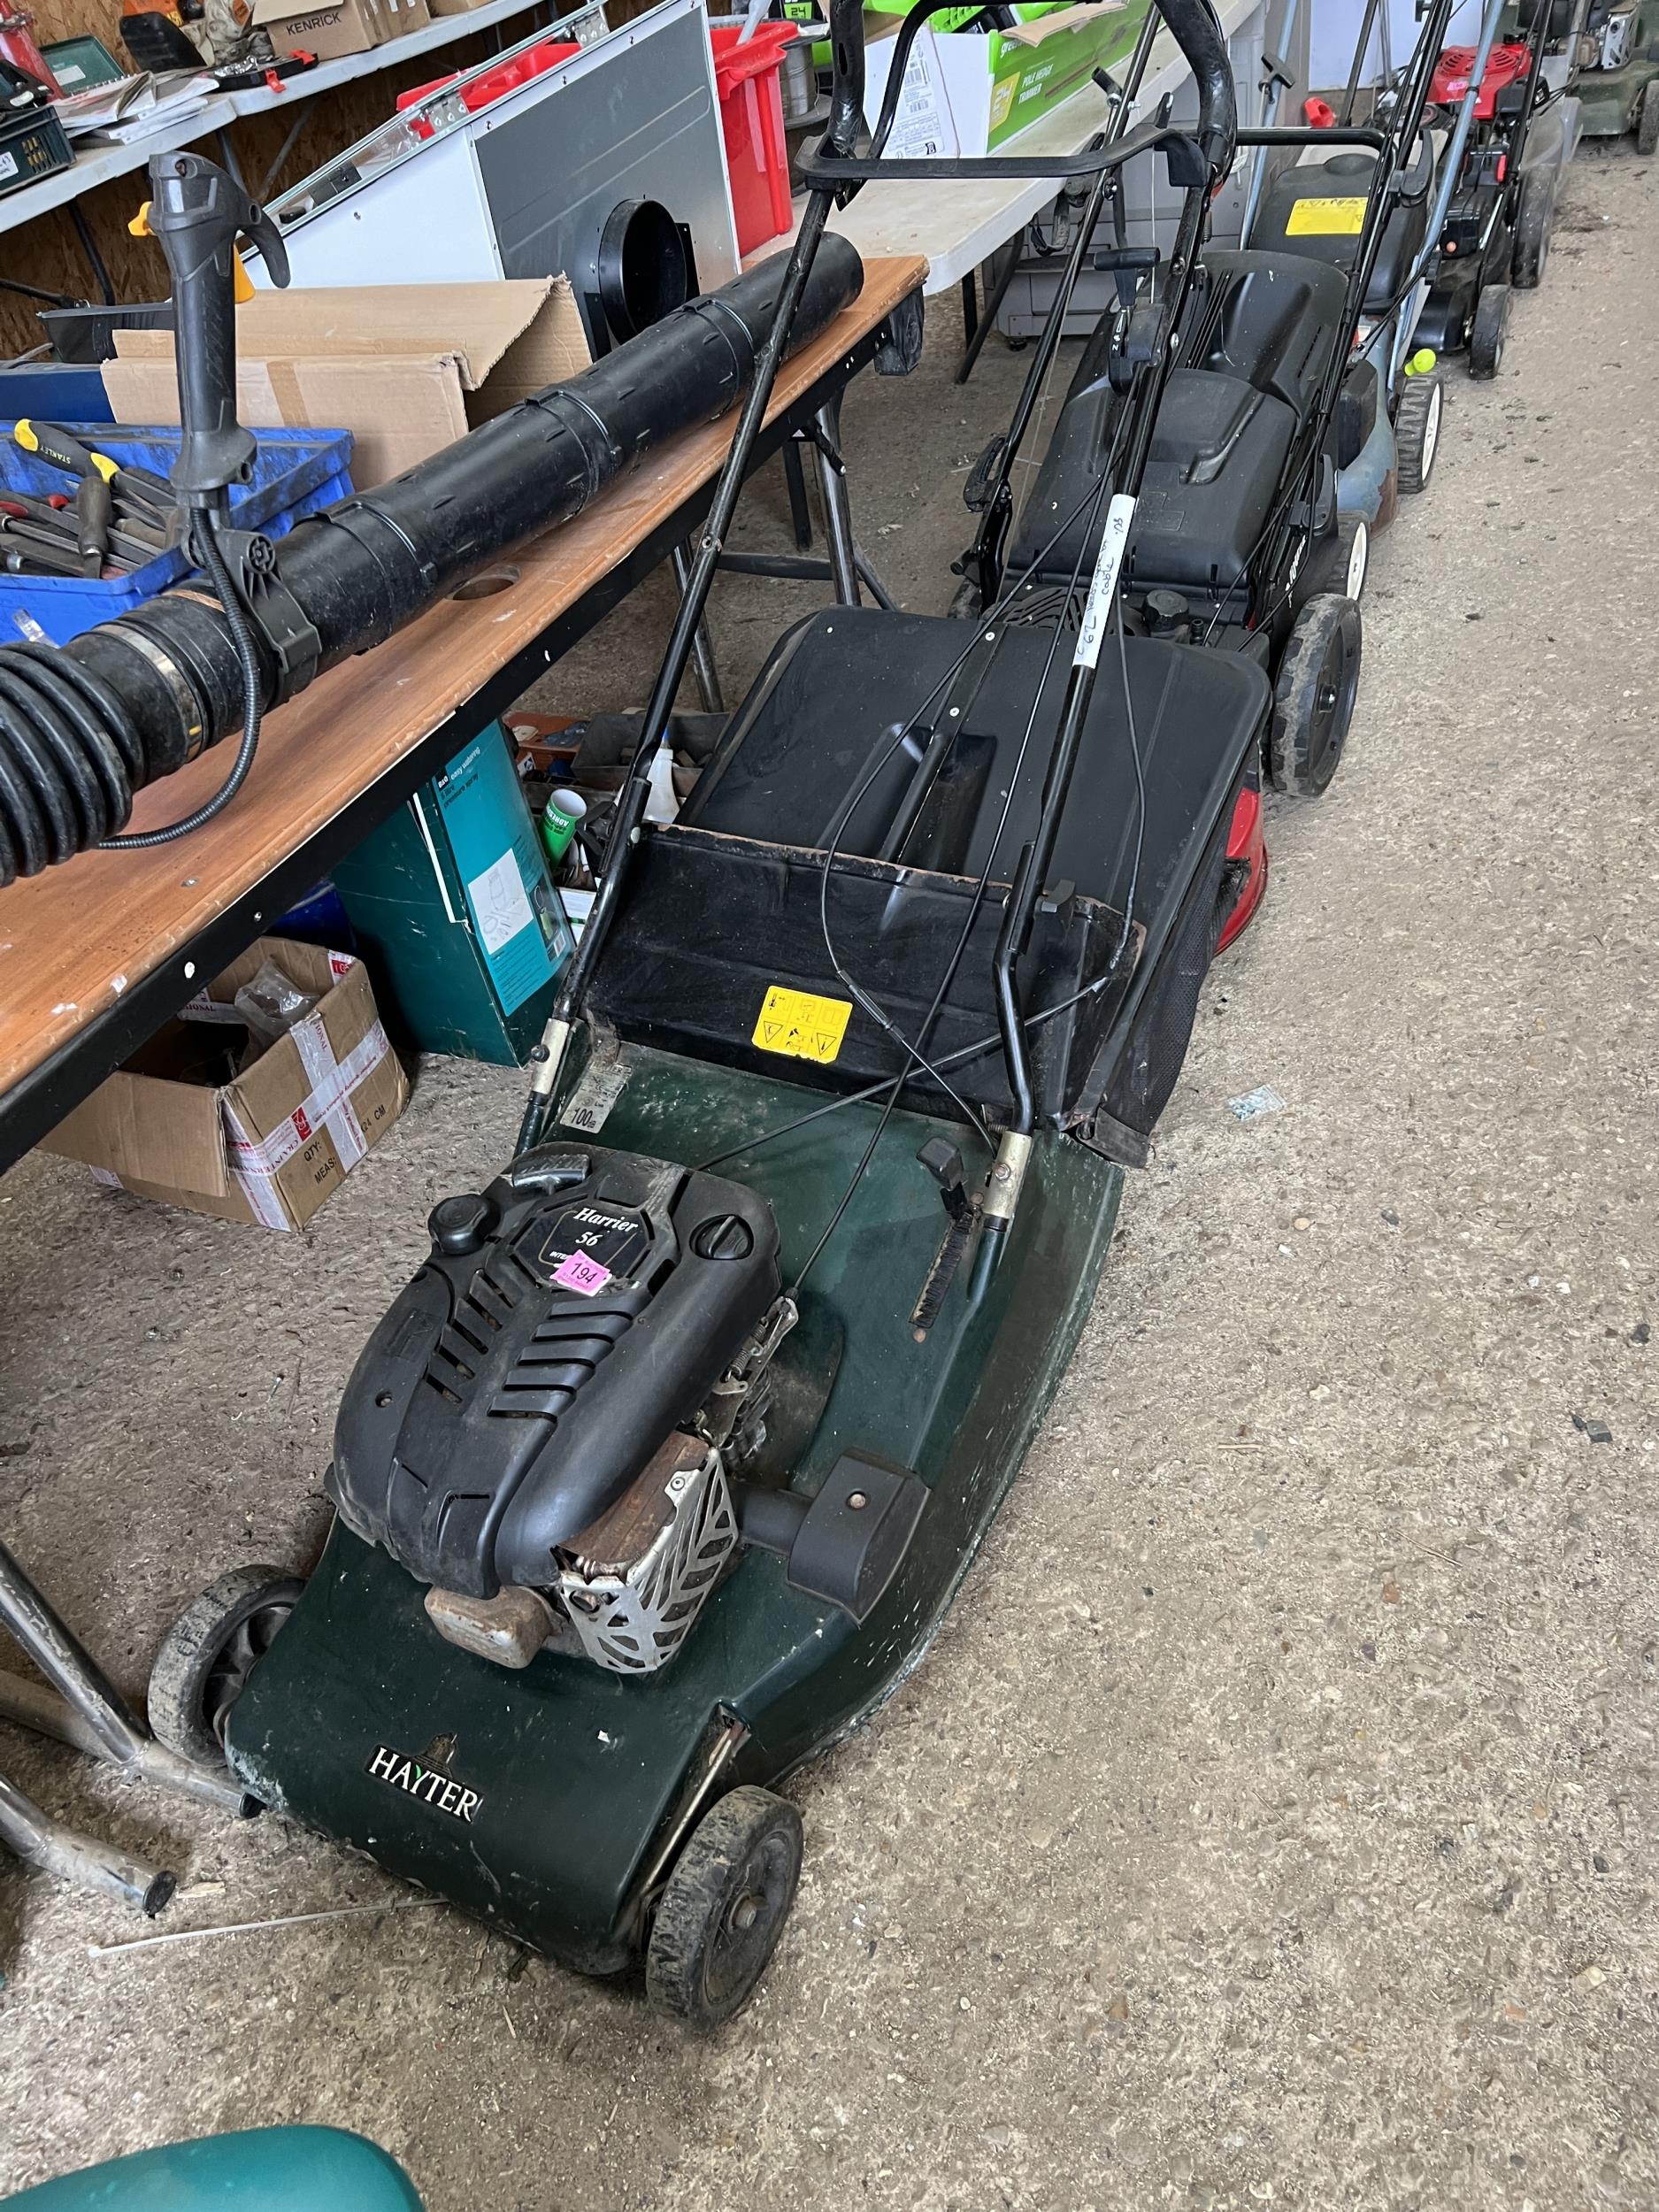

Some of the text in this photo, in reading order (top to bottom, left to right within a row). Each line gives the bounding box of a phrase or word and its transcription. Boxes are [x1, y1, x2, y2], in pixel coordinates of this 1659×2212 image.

[286, 12, 342, 35] KENRICK
[791, 7, 806, 18] 24
[40, 445, 71, 465] STANLEY
[450, 765, 463, 780] easy
[462, 746, 480, 769] watering
[572, 1107, 593, 1126] 100
[303, 1140, 323, 1163] QTY:
[314, 1156, 337, 1185] MEAS:
[374, 1105, 386, 1121] CM
[573, 1208, 638, 1232] Harrier
[575, 1232, 603, 1246] 56
[549, 1251, 567, 1260] INTE
[571, 1263, 598, 1284] 194
[369, 1747, 479, 1823] HAYTER
